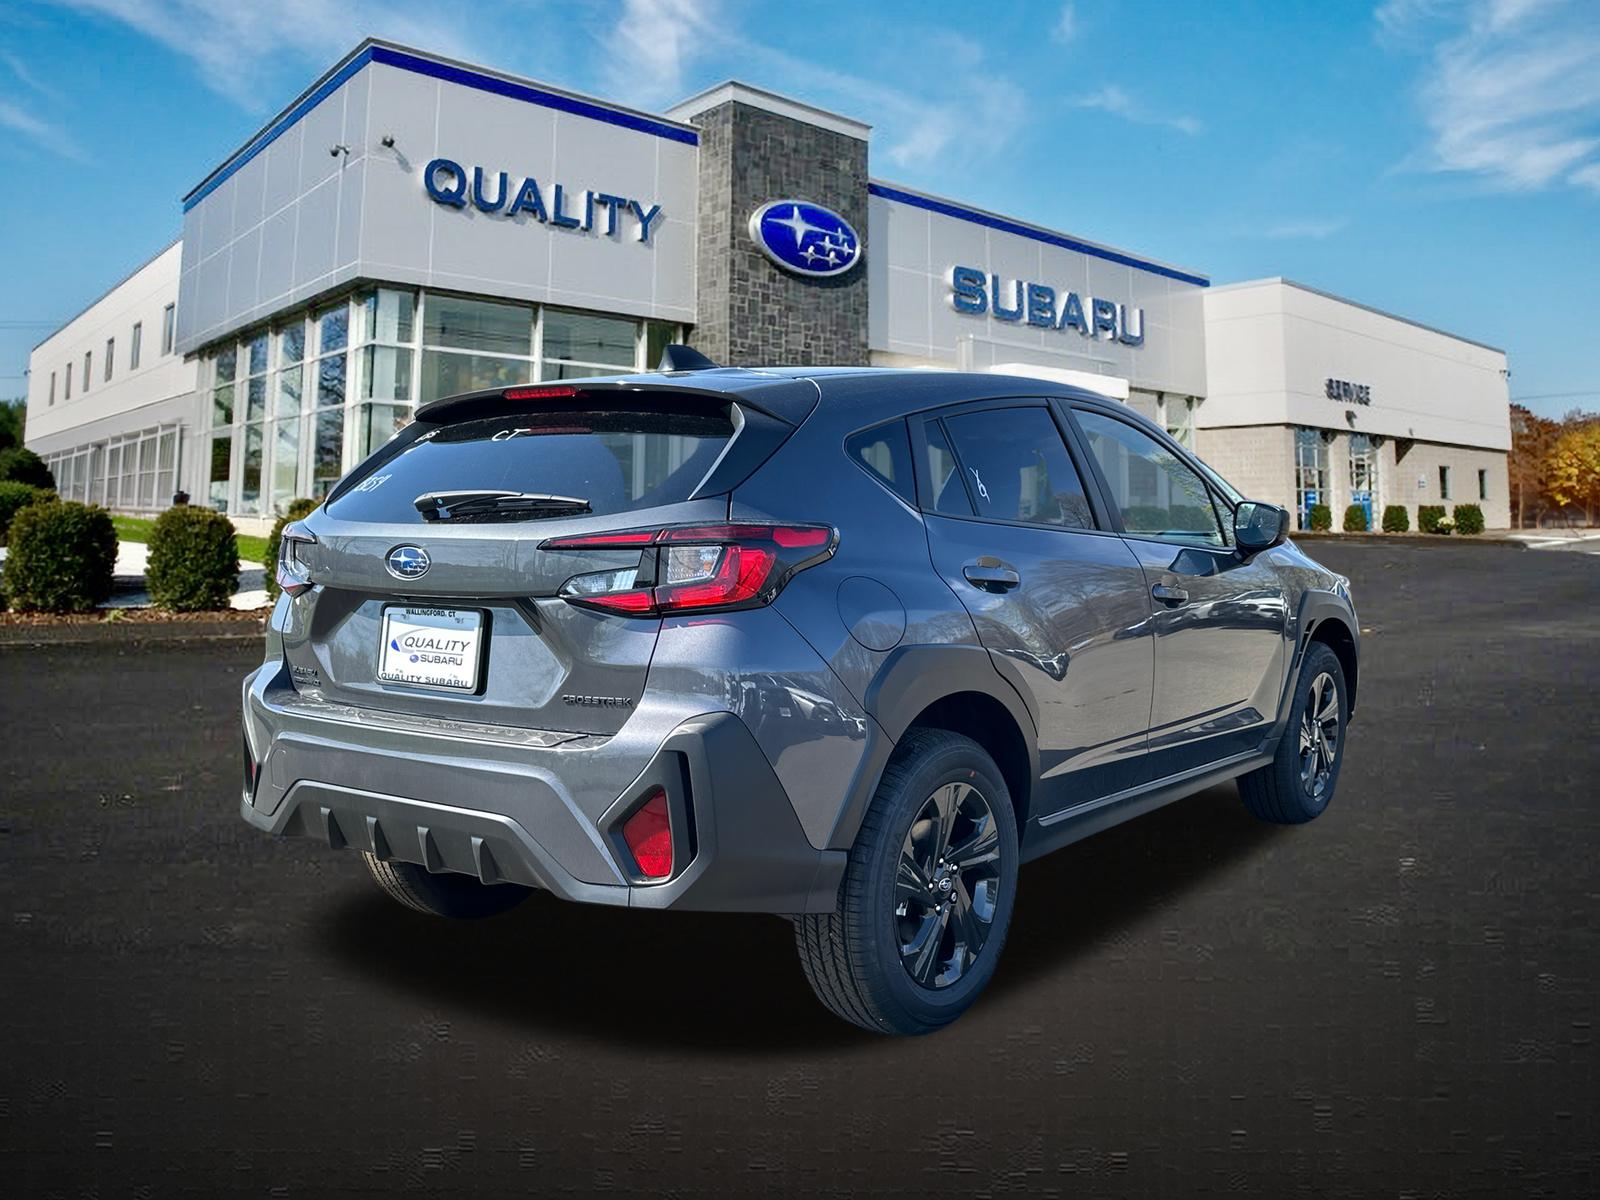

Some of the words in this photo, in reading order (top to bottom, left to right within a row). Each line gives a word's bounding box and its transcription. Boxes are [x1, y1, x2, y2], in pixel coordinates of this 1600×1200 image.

[424, 158, 661, 241] QUALITY
[950, 265, 1145, 346] SUBARU
[404, 636, 471, 652] QUALITY
[420, 654, 463, 666] SUBARU
[380, 672, 422, 682] QUALITY
[424, 676, 468, 688] SUBARU
[562, 694, 632, 706] CROSSTREK
